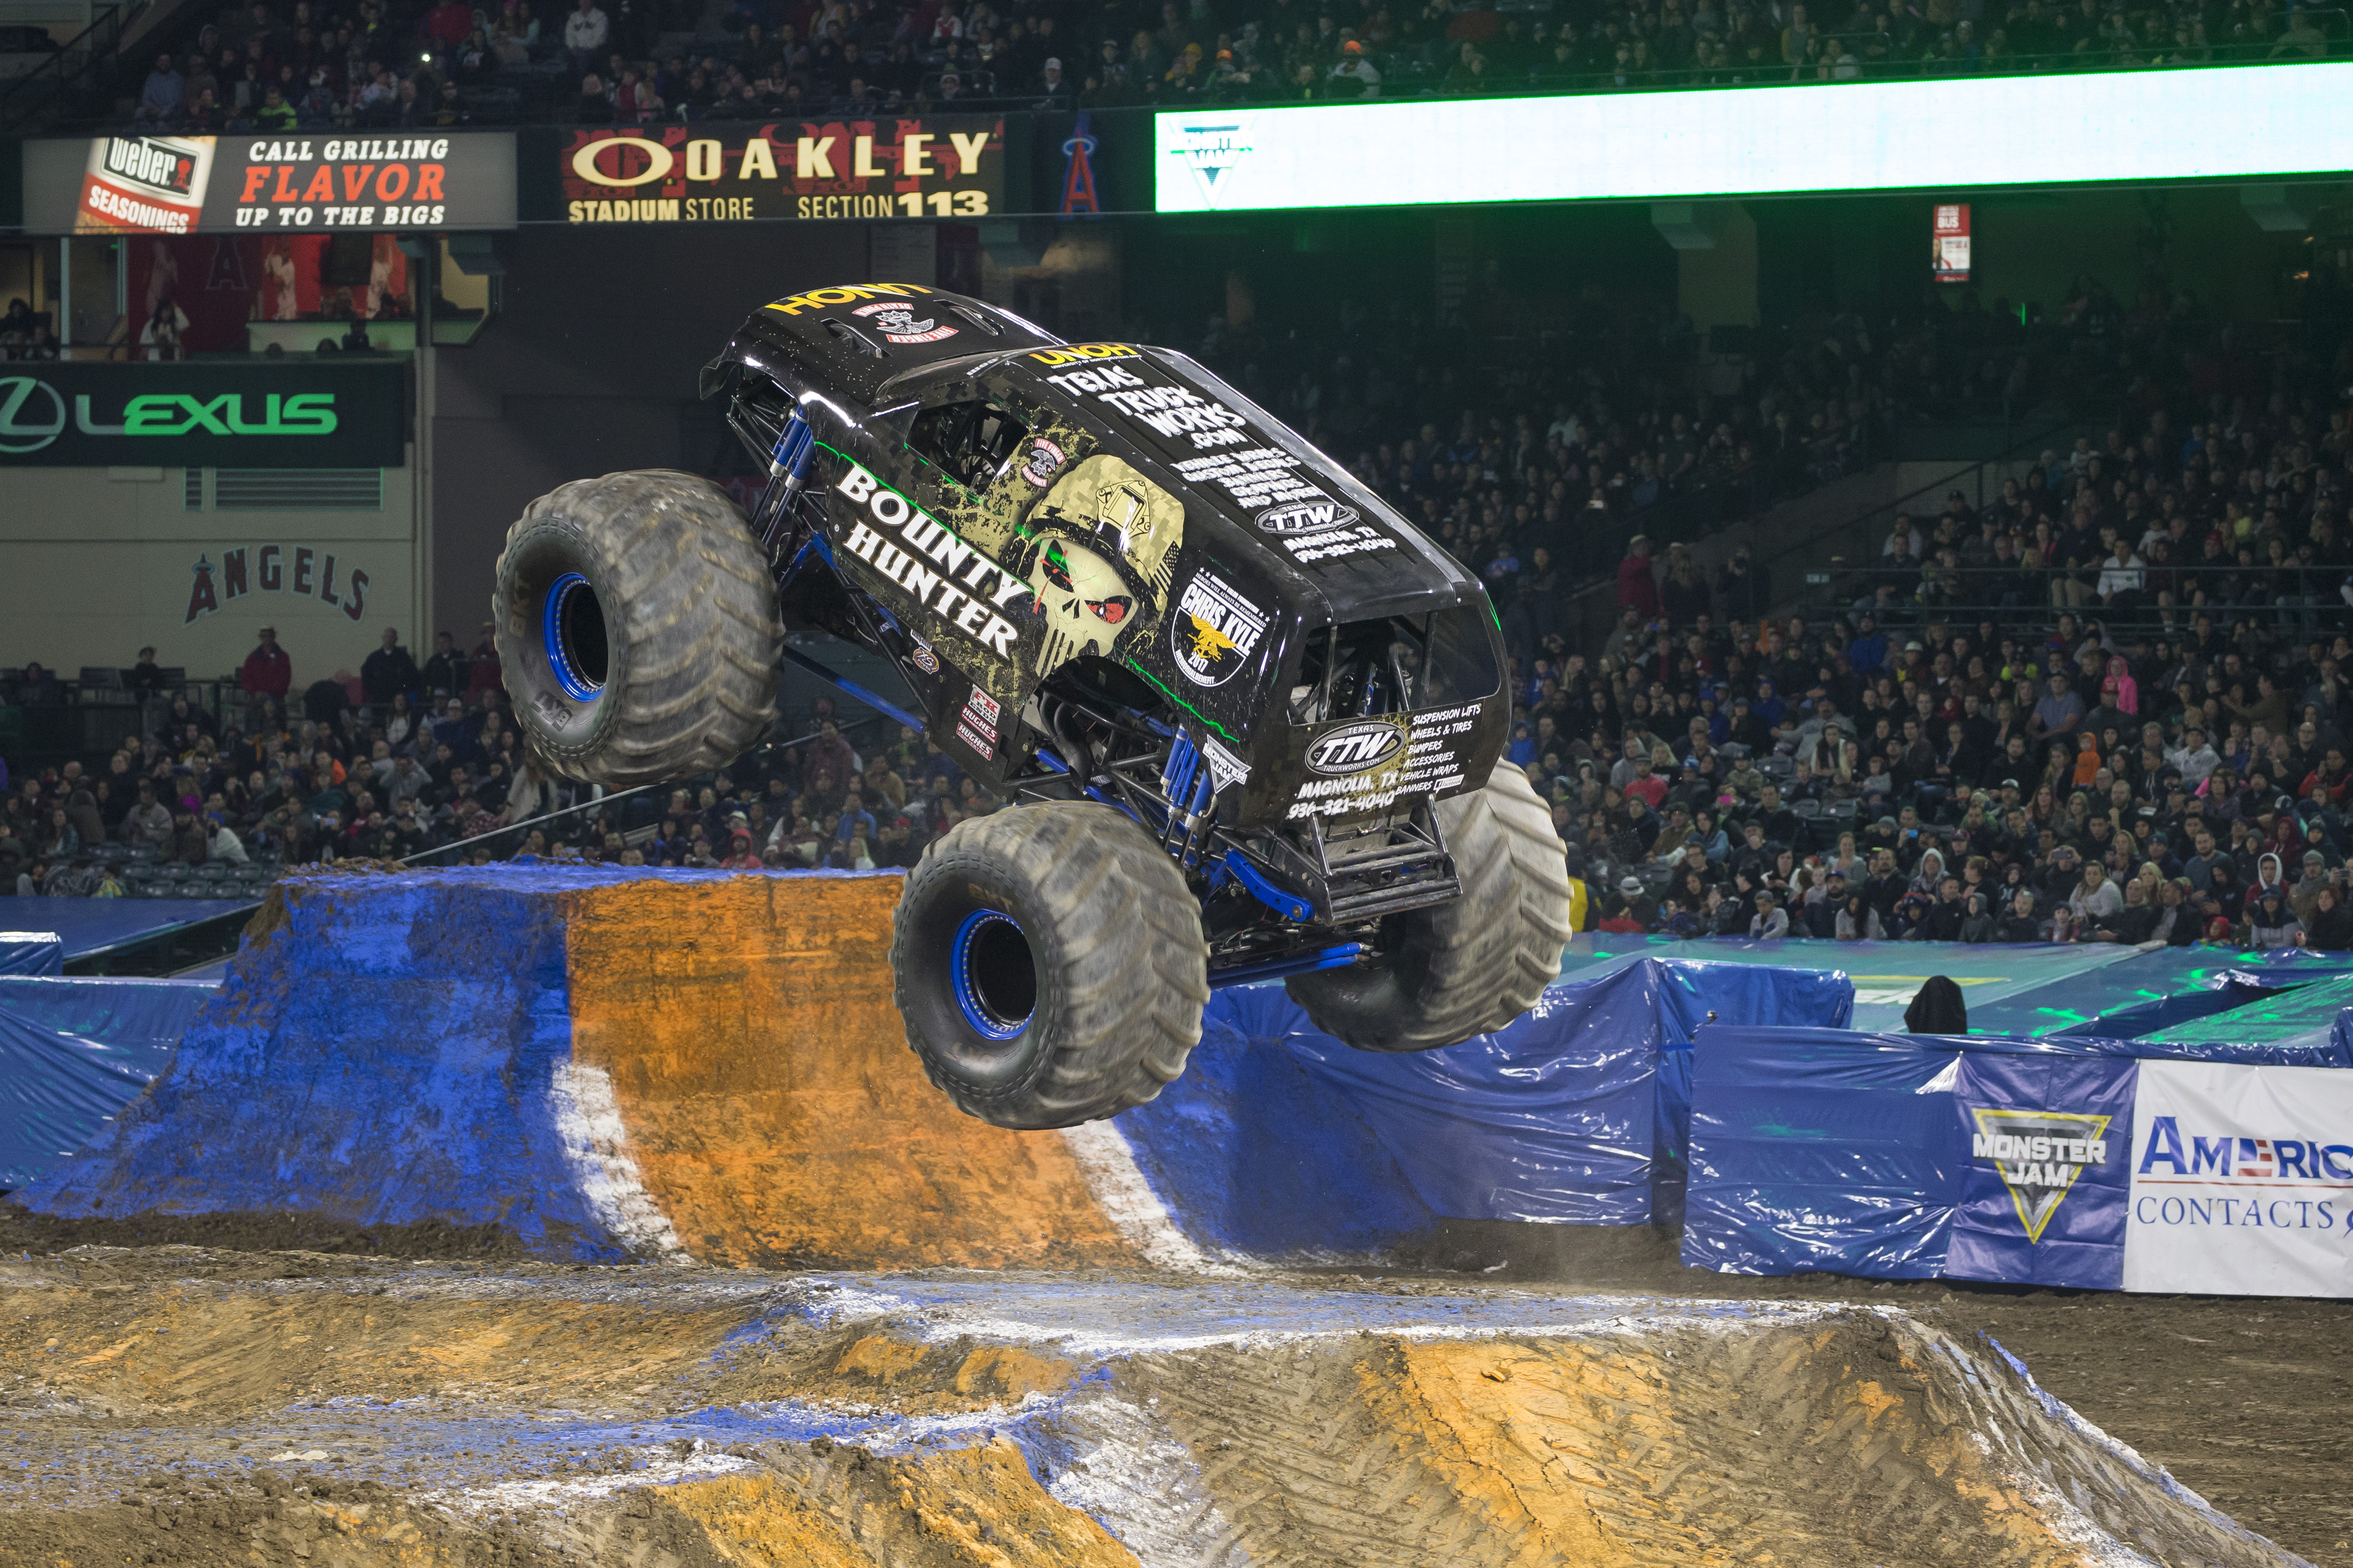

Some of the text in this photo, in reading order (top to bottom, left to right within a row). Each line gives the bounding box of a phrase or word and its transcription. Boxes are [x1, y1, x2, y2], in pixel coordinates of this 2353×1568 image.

[249, 139, 448, 161] CALL GRILLING
[686, 132, 990, 181] OAKLEY
[239, 164, 445, 202] FLAVOR
[89, 185, 189, 234] SEASONINGS
[236, 206, 445, 226] UP TO THE BIGS
[569, 191, 989, 222] STADIUM STORE SECTION 113
[891, 327, 955, 343] FIVE FINGER
[1028, 344, 1138, 365] UNOH
[1051, 360, 1081, 369] UNIVERSITY
[1047, 366, 1144, 396] TEXAS
[1098, 386, 1204, 416] TRUCK
[76, 393, 338, 436] LEXUS
[1134, 402, 1246, 438] WORKS
[1037, 439, 1064, 464] FIVE FINGER
[1169, 447, 1287, 472] VEHICLE WRAPS
[1181, 456, 1301, 482] CUSTOM DECALS
[1217, 469, 1291, 488] BANNERS
[1230, 478, 1305, 497] GRAPHICS
[1237, 495, 1272, 508] AND
[1269, 505, 1335, 531] TTW
[835, 463, 1034, 609] BOUNTY
[1355, 526, 1382, 538] TX
[182, 544, 370, 626] ANGELS
[843, 519, 1018, 660] HUNTER
[1210, 575, 1260, 615] AMERICAN VALOR FOUNDATION
[1195, 572, 1211, 586] HEROES
[1210, 583, 1221, 594] WILL
[1220, 589, 1235, 605] ALWAYS
[1240, 605, 1267, 628] REMEMBERED
[1180, 583, 1261, 657] CHRIS KYLE
[915, 650, 934, 666] XS
[1188, 652, 1209, 673] 2017
[963, 707, 997, 738] HUGHES
[970, 702, 995, 723] ENDS
[976, 701, 996, 719] ROD
[1412, 704, 1481, 726] SUSPENSION LIFTS
[958, 725, 991, 755] HUGHES
[962, 713, 996, 743] TRANSMISSIONS
[1348, 725, 1374, 735] TEXAS
[1410, 720, 1473, 740] WHEELS & TIRES
[1315, 730, 1395, 767] TTW
[1407, 740, 1444, 754] BUMPERS
[1202, 742, 1246, 782] MONSTER
[1212, 763, 1231, 782] JAM
[1323, 758, 1380, 772] TRUCKWORKS.COM
[1400, 763, 1460, 782] VEHICLE WRAPS
[1403, 751, 1455, 769] ACCESSORIES
[1381, 770, 1399, 788] TX
[1394, 780, 1434, 796] BANNERS
[1287, 789, 1395, 820] 936-321-4040
[1973, 1133, 2106, 1164] MONSTER
[2007, 1162, 2069, 1187] JAM
[2137, 1197, 2334, 1229] CONTACTS
